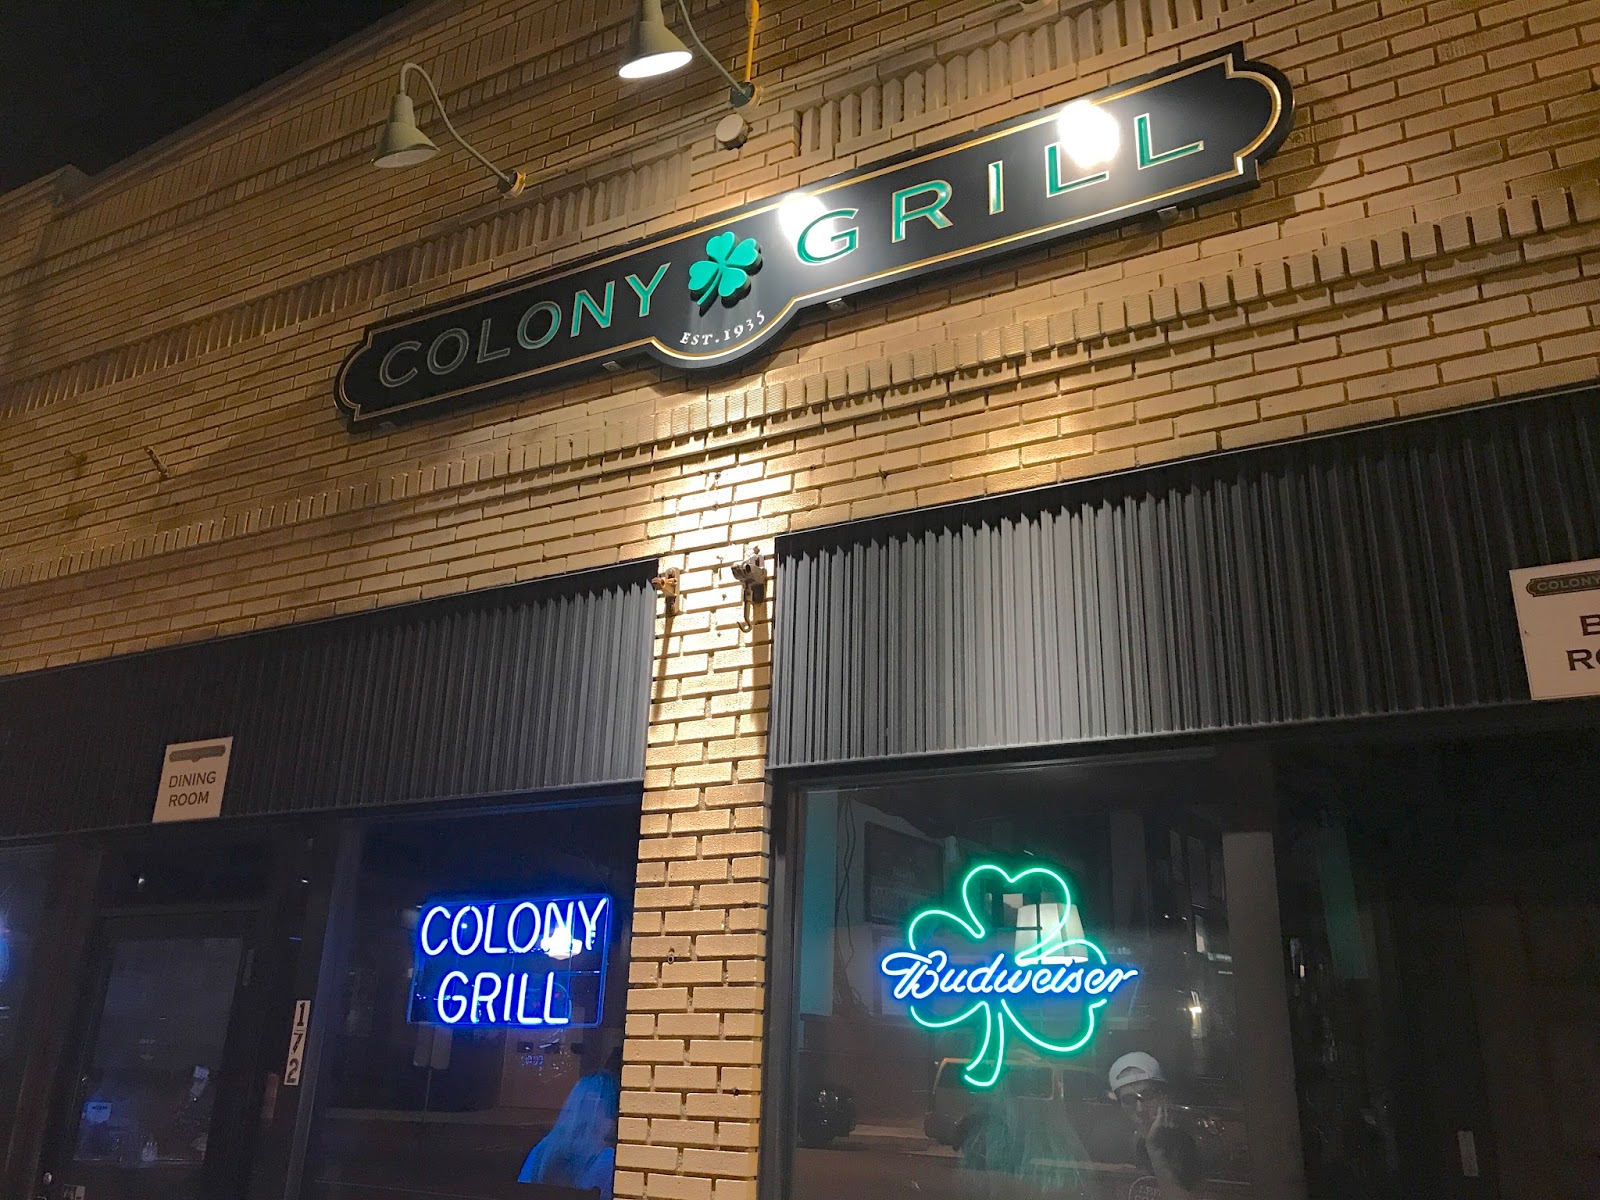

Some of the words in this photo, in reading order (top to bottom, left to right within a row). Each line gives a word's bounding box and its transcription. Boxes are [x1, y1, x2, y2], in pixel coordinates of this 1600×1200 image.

[379, 262, 672, 388] COLONY
[796, 113, 1204, 264] GRILL
[723, 310, 765, 341] 1935
[168, 770, 217, 788] DINING
[168, 791, 210, 807] ROOM
[421, 897, 608, 956] COLONY
[437, 970, 569, 1024] GRILL
[881, 950, 1139, 999] Budweiser
[286, 1002, 306, 1083] 172
